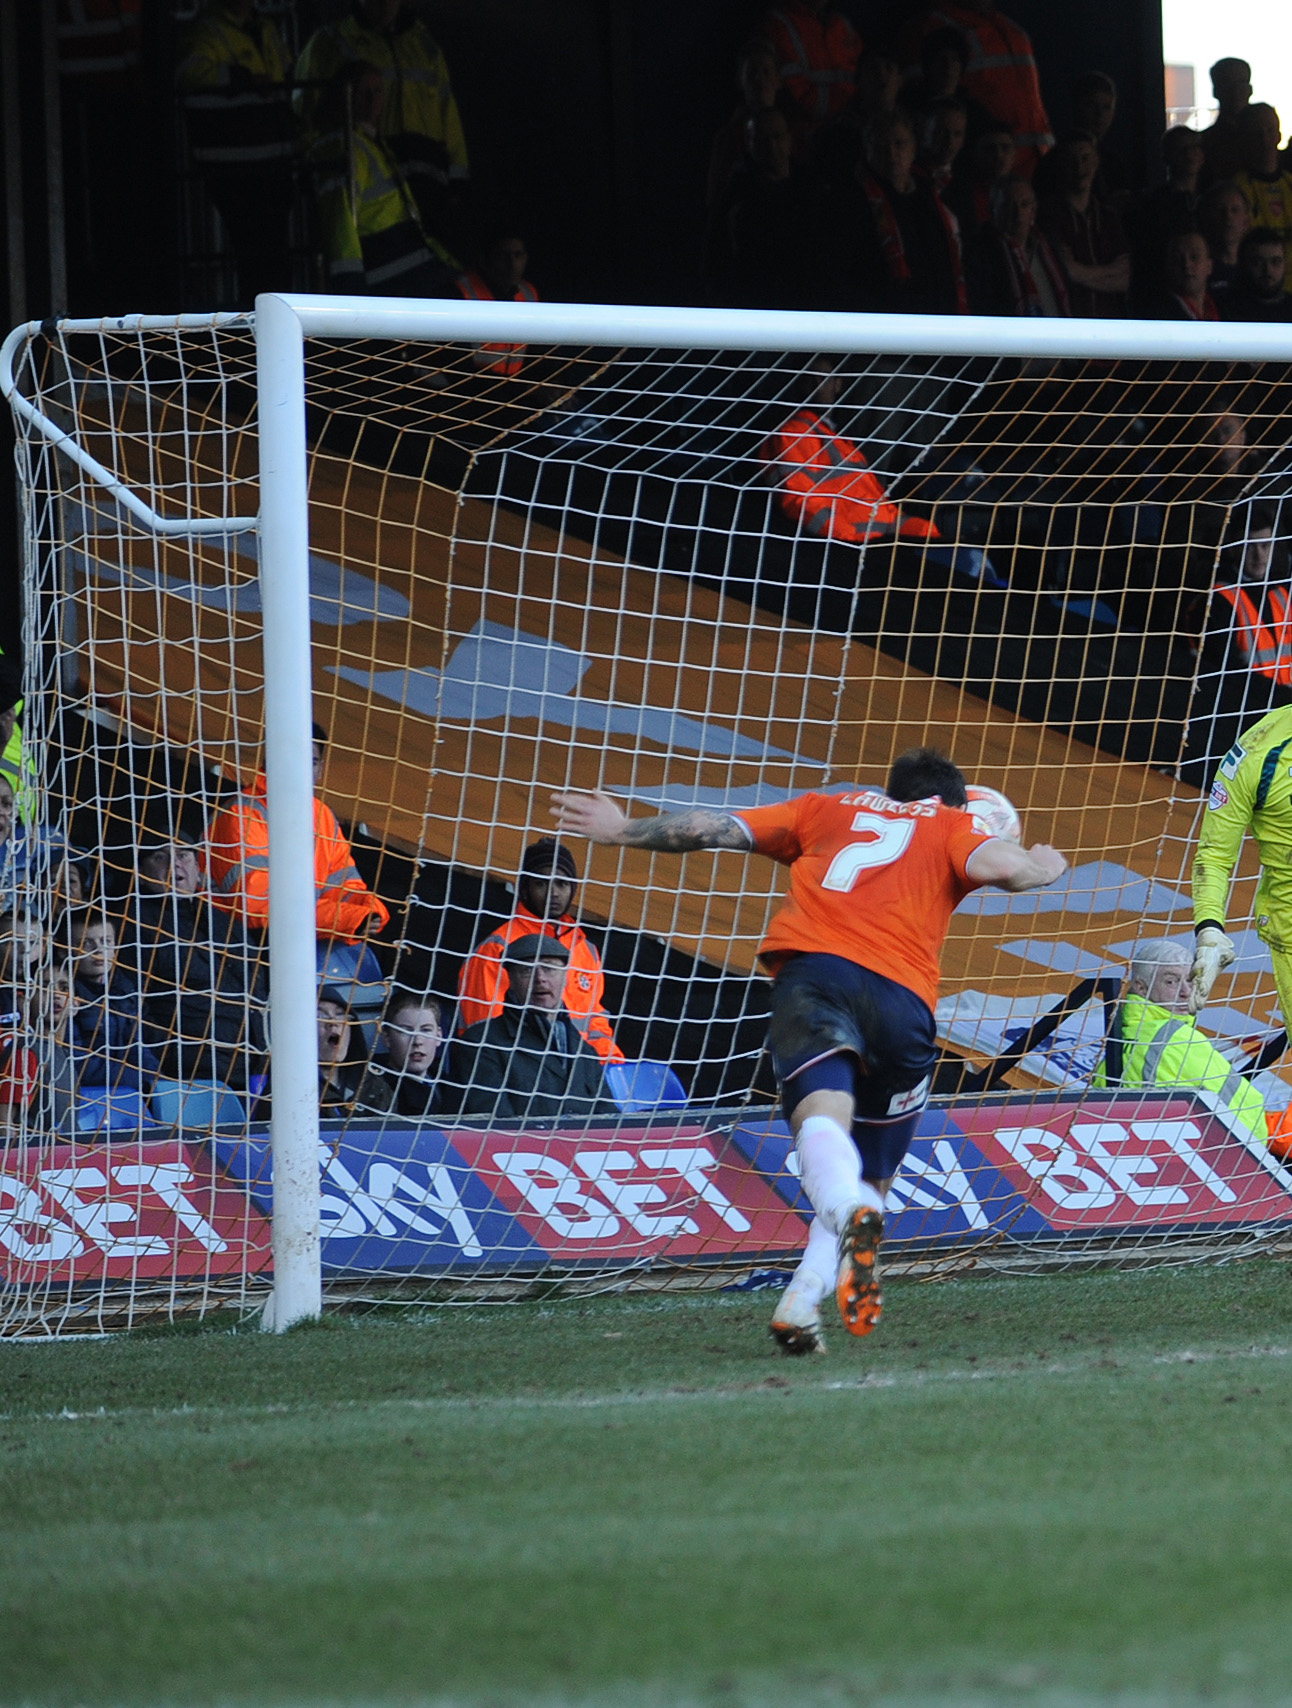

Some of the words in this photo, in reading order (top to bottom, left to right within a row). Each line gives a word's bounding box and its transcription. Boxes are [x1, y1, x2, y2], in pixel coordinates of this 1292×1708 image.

[821, 811, 918, 893] 7
[492, 1148, 751, 1239] BET
[994, 1121, 1237, 1209] BET
[0, 1163, 228, 1262] BET
